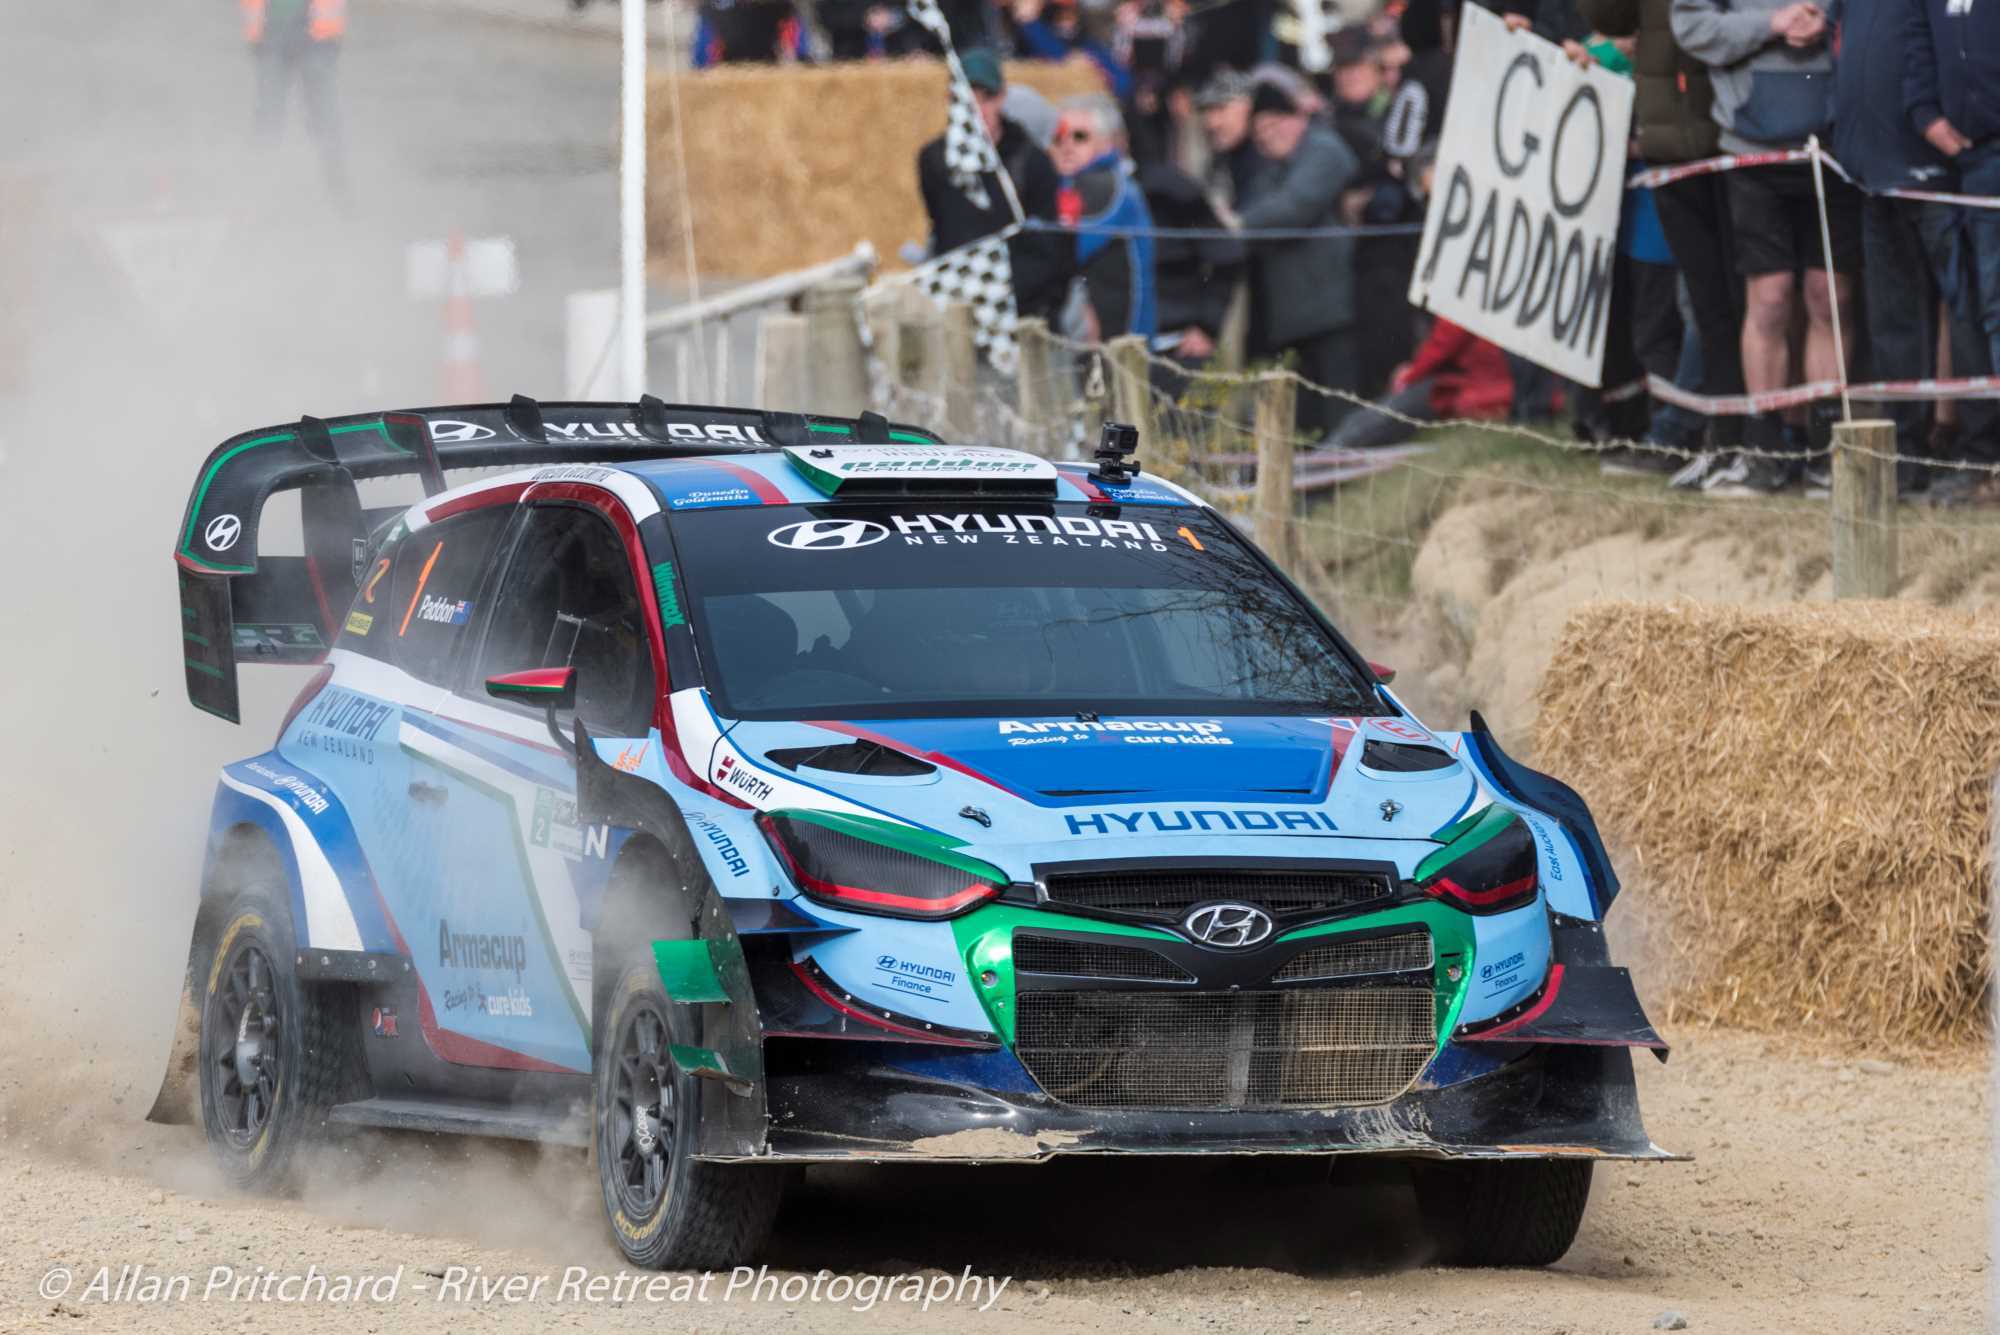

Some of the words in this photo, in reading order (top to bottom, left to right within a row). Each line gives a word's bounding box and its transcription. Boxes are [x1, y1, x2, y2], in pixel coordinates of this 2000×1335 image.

[1495, 52, 1604, 219] GO
[1422, 164, 1615, 358] PADDON
[890, 514, 1162, 542] HYUNDAI
[1177, 526, 1205, 552] 1
[904, 534, 979, 545] NEW
[1003, 534, 1168, 552] ZEALAND
[416, 594, 456, 624] Paddon
[307, 689, 394, 742] HYUNDAI
[998, 720, 1224, 736] Armacup
[323, 735, 375, 765] ZEALAND
[1008, 734, 1068, 747] Racing
[1063, 810, 1339, 835] HYUNDAI
[697, 818, 750, 878] HYUNDAI
[439, 918, 526, 985] Armacup
[1494, 951, 1525, 973] HYUNDAI
[891, 975, 933, 994] Finance
[899, 960, 956, 983] HYUNDAI
[1494, 973, 1519, 991] Finance
